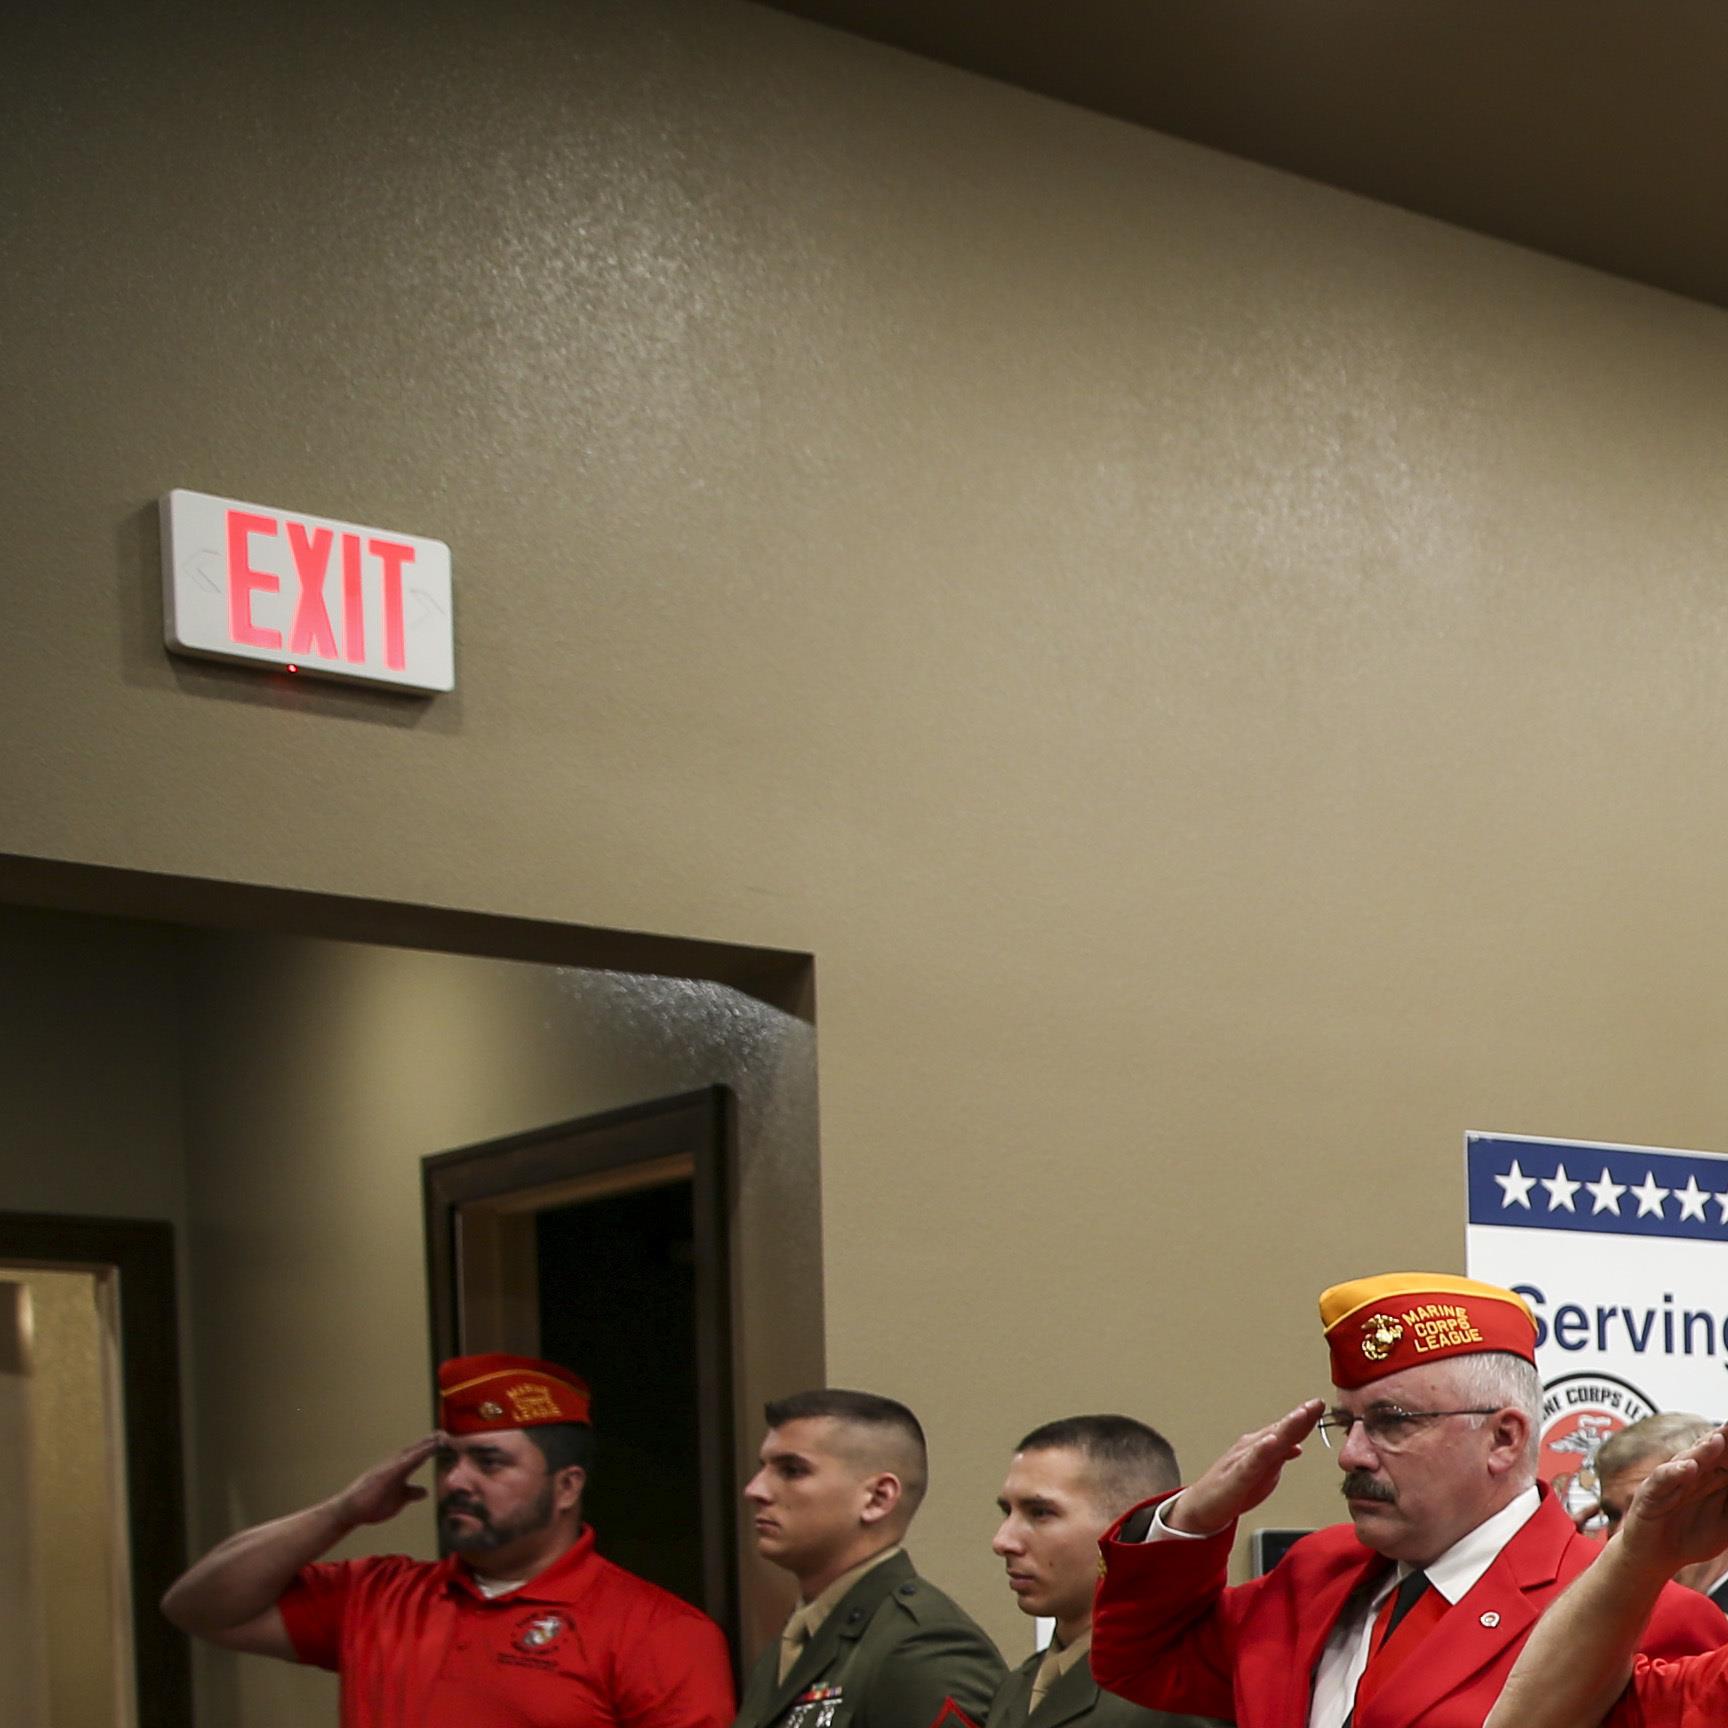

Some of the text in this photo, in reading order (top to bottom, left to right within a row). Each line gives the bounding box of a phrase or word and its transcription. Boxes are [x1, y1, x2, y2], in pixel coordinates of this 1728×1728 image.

[226, 509, 415, 672] EXIT
[1401, 1304, 1468, 1327] MARINE
[1414, 1317, 1471, 1338] CORPS
[1413, 1328, 1483, 1353] LEAGUE
[1565, 1384, 1622, 1409] CORPS
